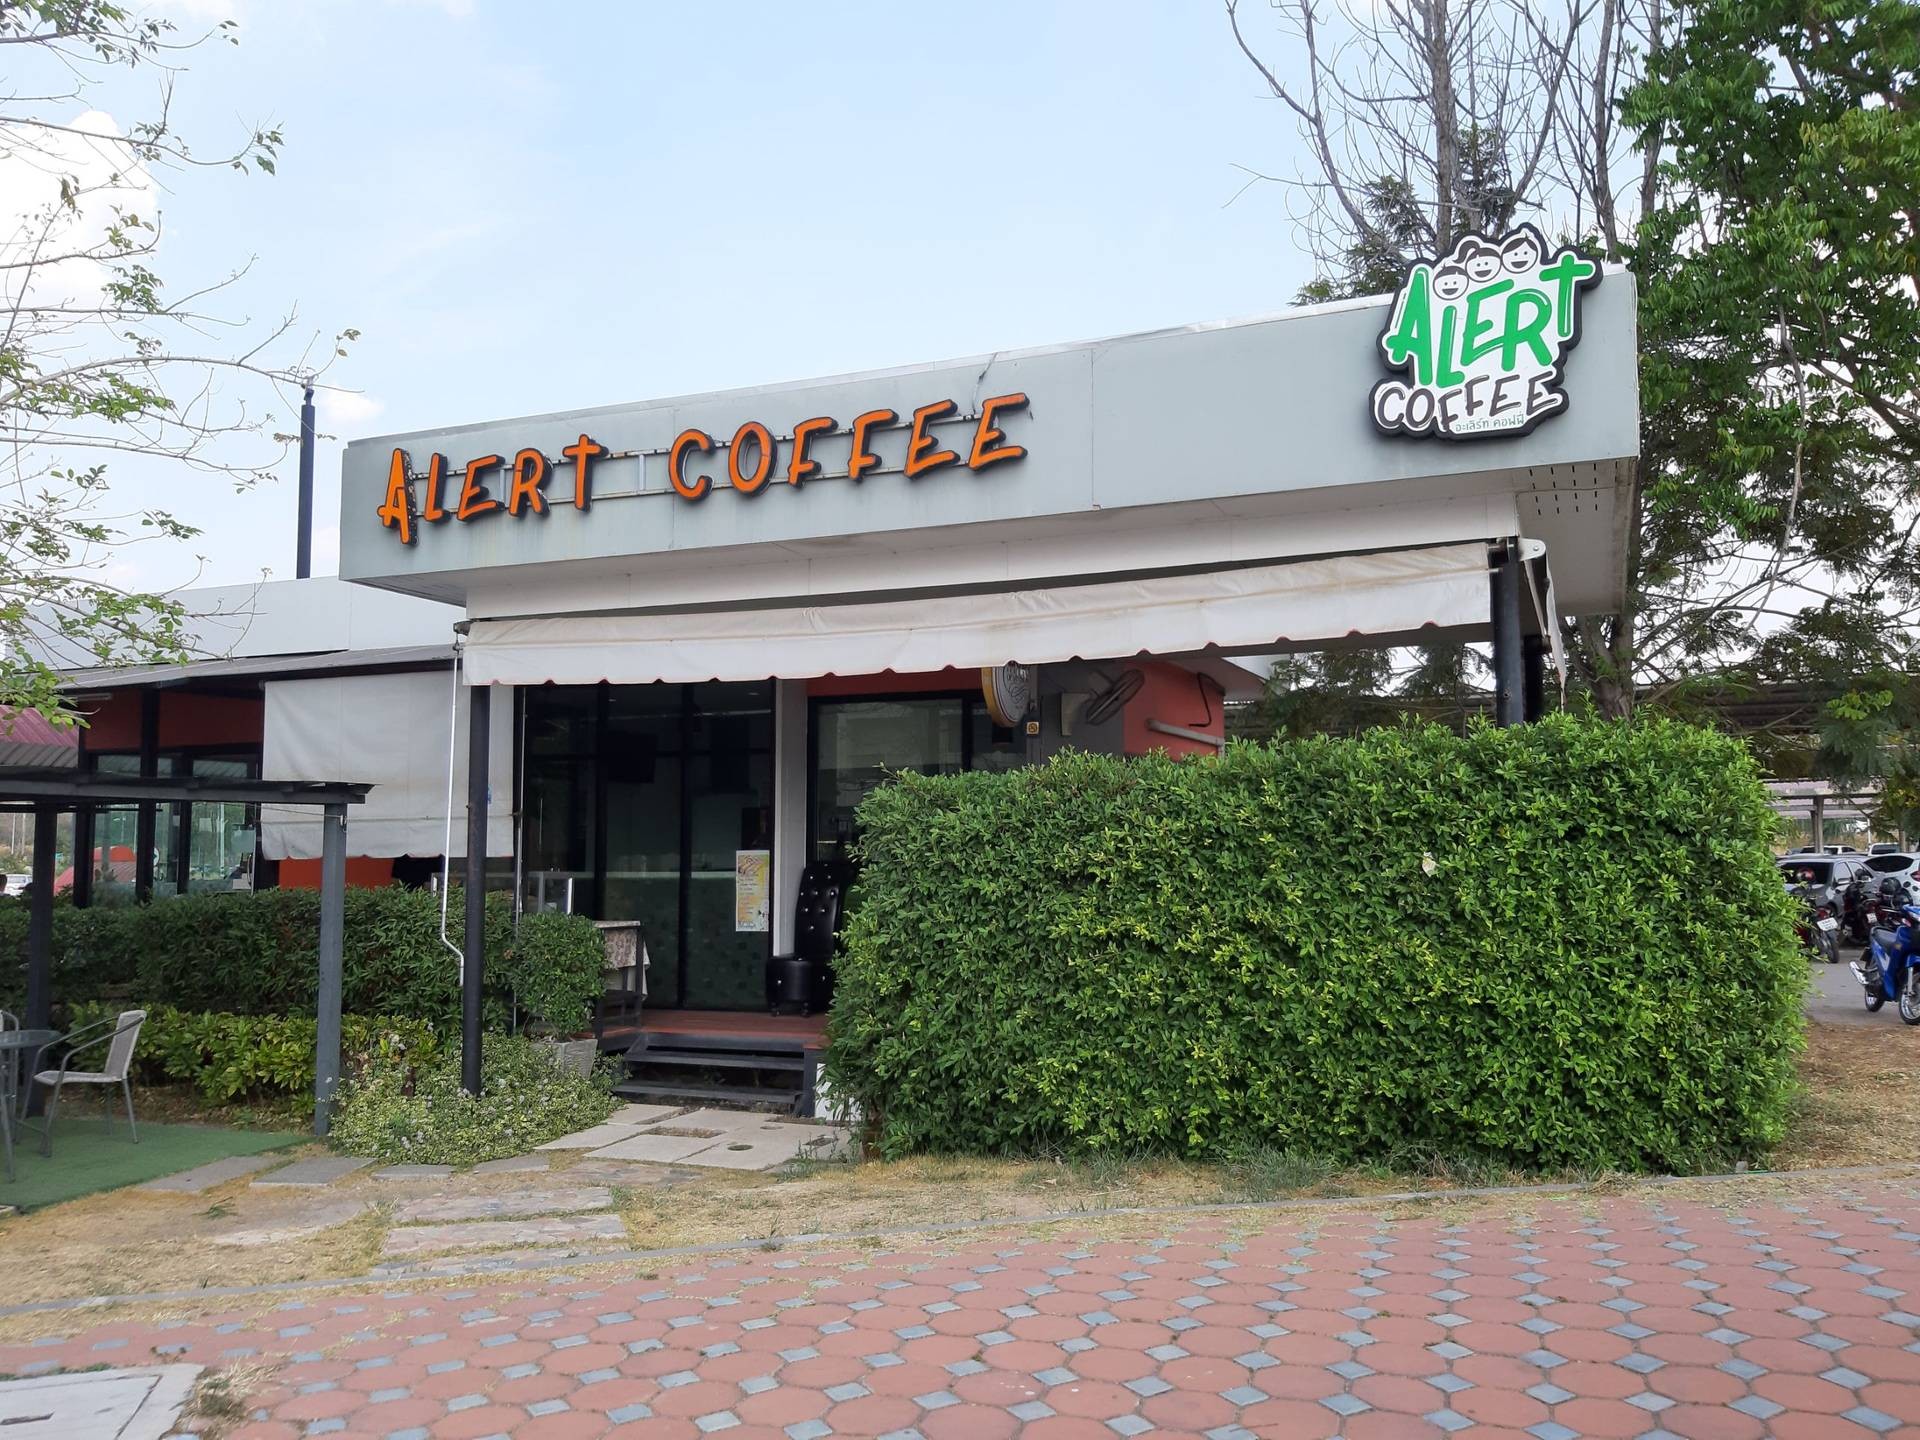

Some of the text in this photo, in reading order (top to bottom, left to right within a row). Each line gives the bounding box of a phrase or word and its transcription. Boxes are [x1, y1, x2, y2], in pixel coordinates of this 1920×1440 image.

[1377, 371, 1559, 430] COFFEE
[376, 392, 1029, 546] ALERT COFFEE
